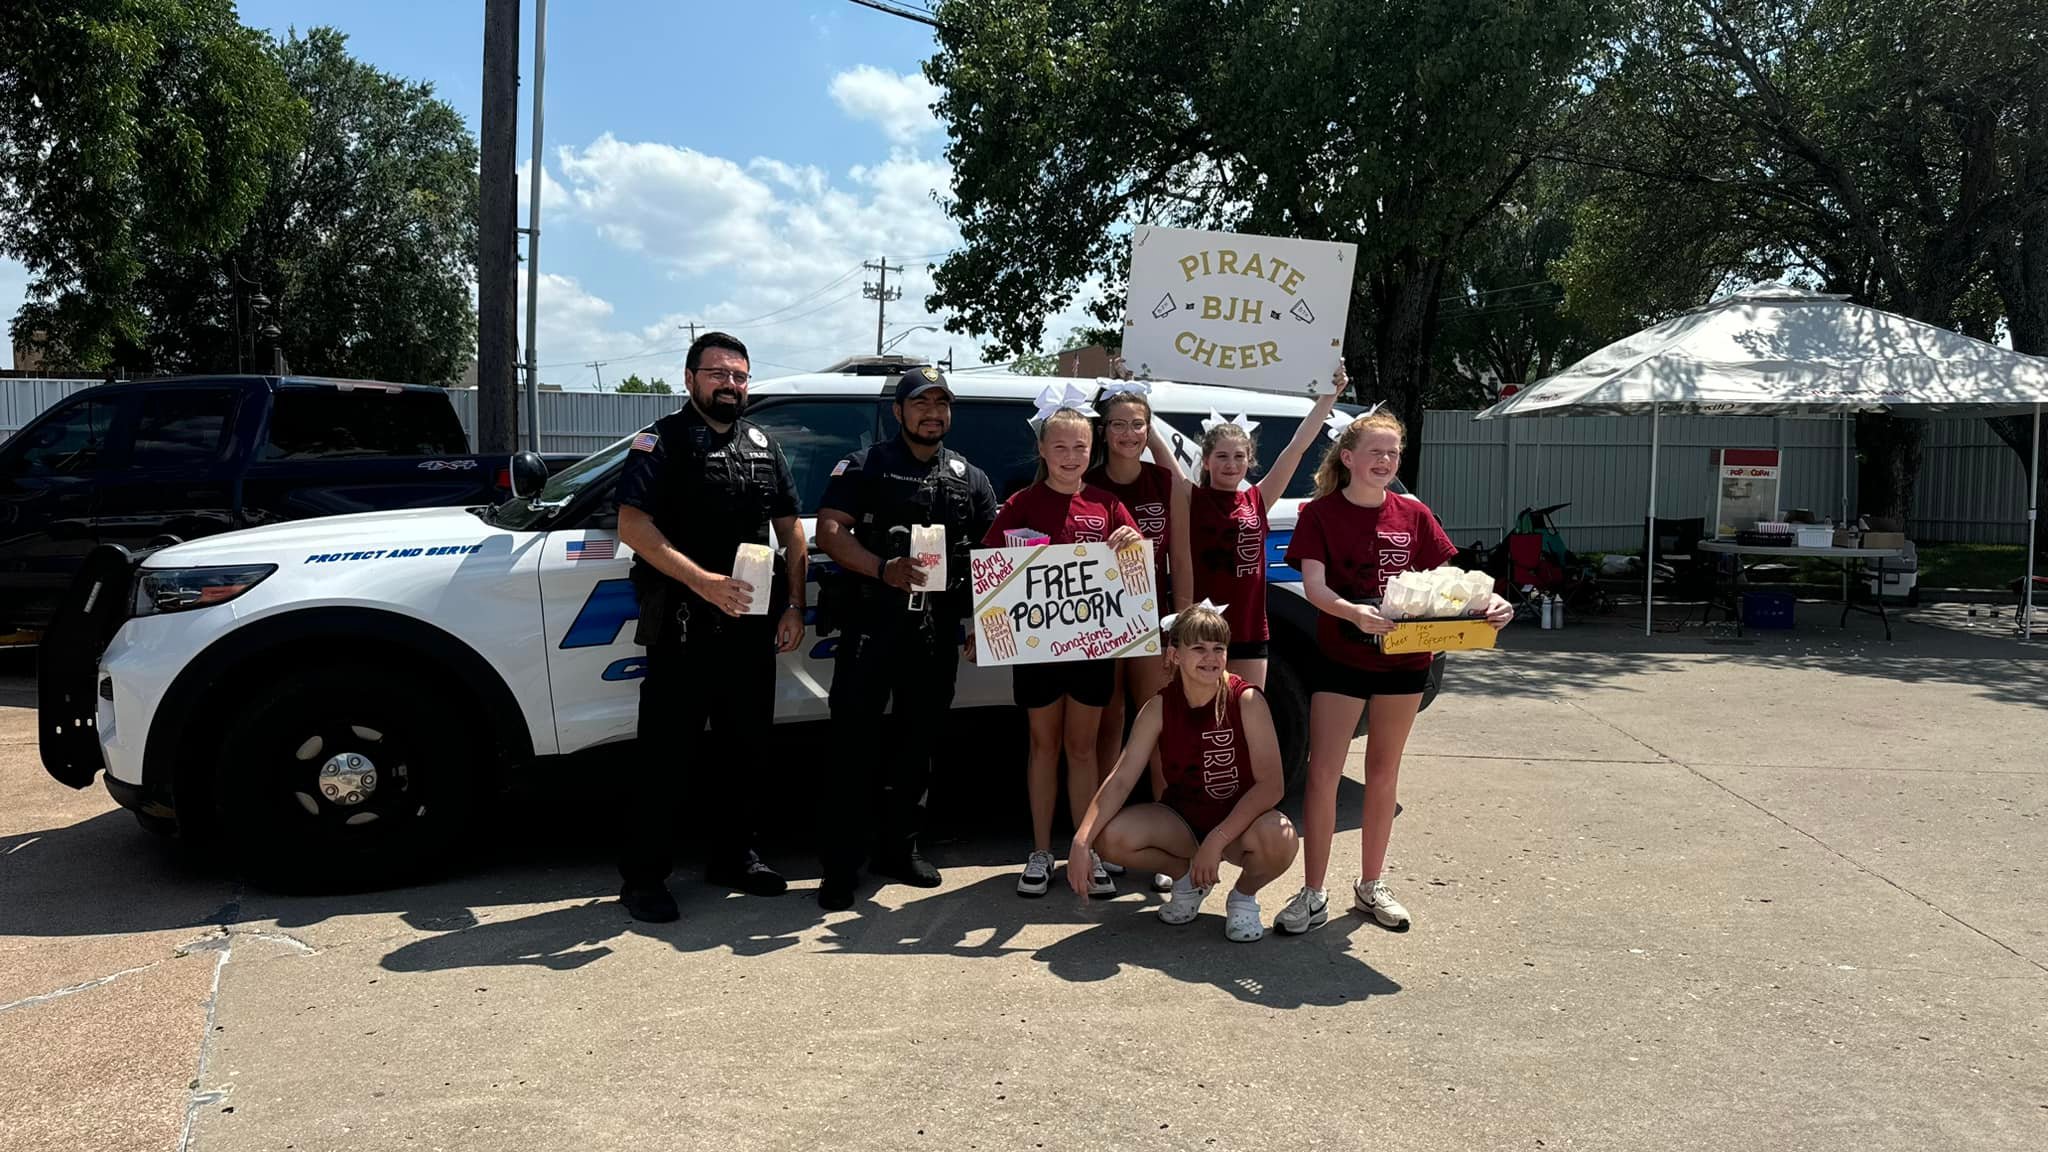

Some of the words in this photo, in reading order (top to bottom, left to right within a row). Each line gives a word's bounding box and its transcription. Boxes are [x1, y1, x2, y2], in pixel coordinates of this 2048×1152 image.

[1177, 249, 1306, 297] PIRATE
[1200, 295, 1264, 324] BJH
[1174, 331, 1283, 369] CHEER
[304, 549, 387, 565] PROTECT
[386, 547, 424, 560] AND
[424, 544, 483, 556] SERVE
[1229, 503, 1263, 578] PRIDE
[972, 550, 1006, 580] Byng
[974, 578, 991, 595] JH
[987, 557, 1014, 588] Cheer
[1026, 560, 1102, 601] FREE
[1009, 589, 1125, 632] POPCORN
[1051, 627, 1113, 657] Donations
[1079, 614, 1150, 660] Welcome!!!
